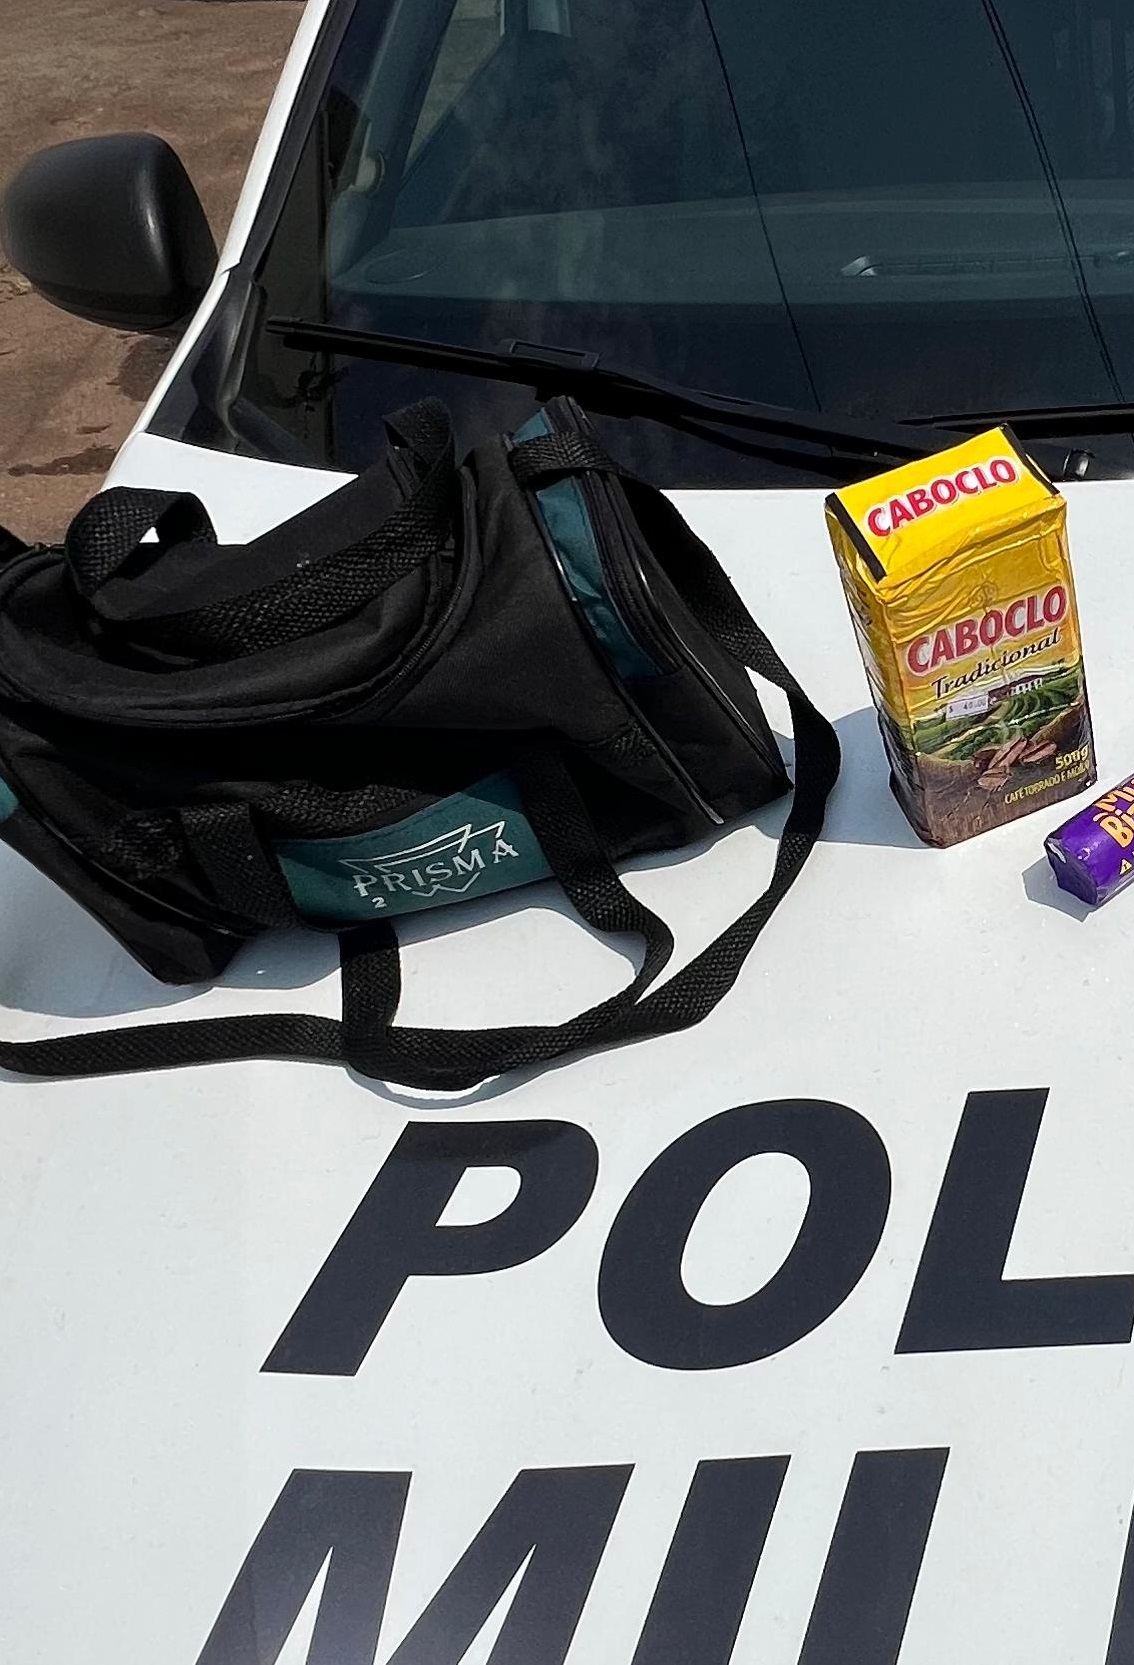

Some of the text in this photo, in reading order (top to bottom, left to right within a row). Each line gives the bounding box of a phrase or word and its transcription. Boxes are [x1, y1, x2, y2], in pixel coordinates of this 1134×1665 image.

[867, 458, 1017, 537] CABOCLO
[907, 585, 1067, 674] CABOCLO
[931, 627, 1062, 699] Tradicional
[1060, 770, 1067, 782] E
[352, 838, 520, 897] PRISMA
